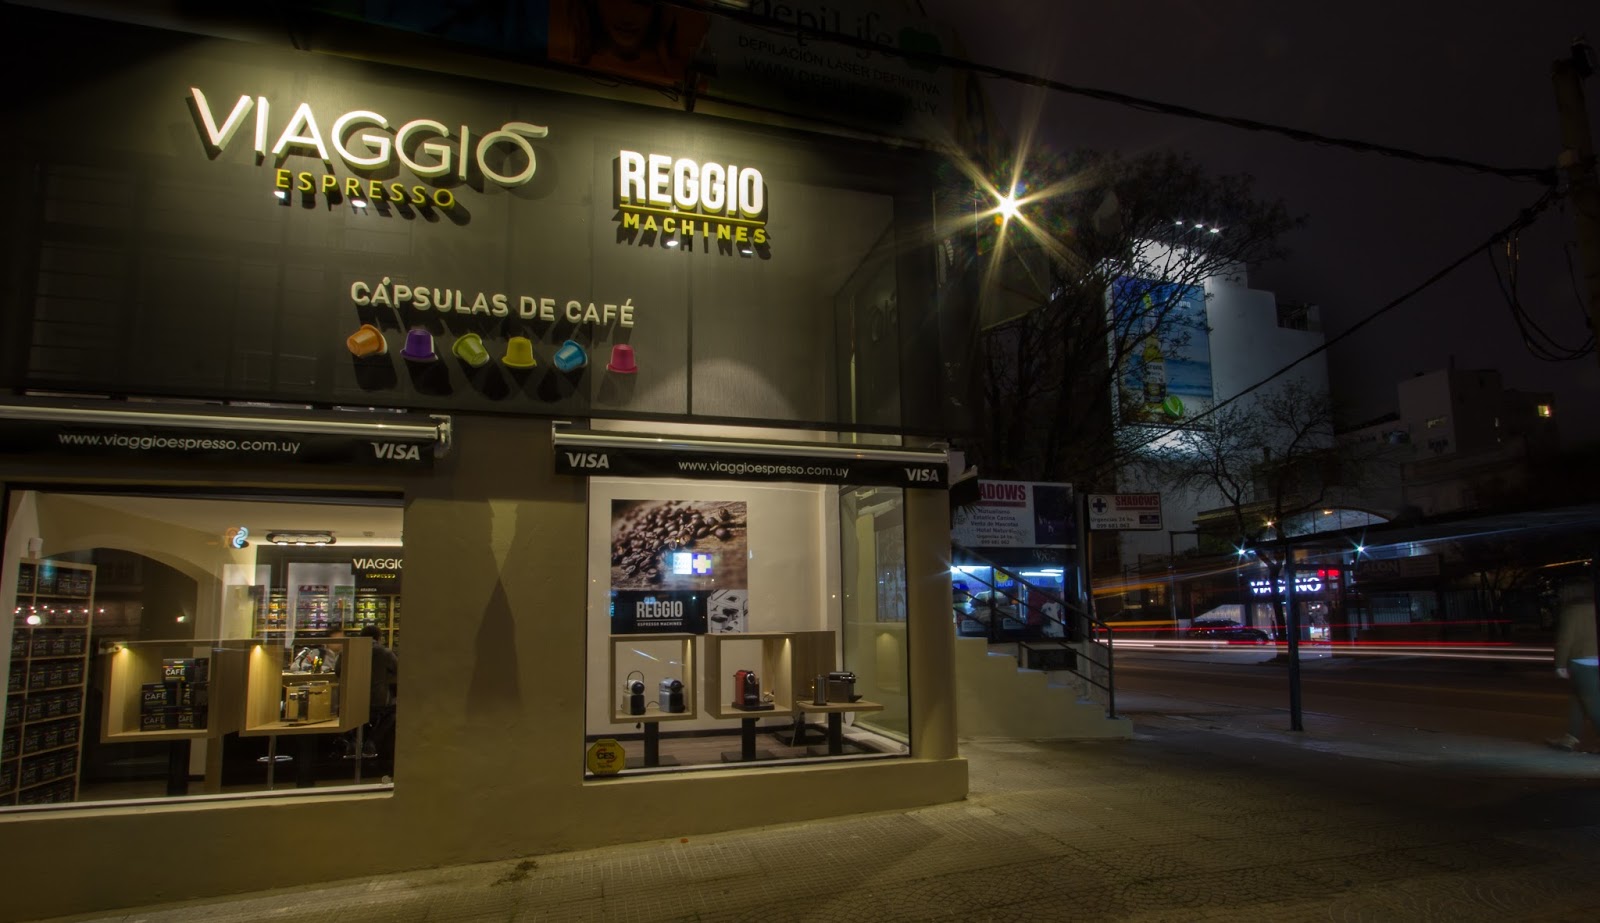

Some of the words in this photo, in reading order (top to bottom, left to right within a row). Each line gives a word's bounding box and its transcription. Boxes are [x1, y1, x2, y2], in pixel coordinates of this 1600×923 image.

[275, 169, 456, 209] ESPRESSO
[619, 149, 764, 219] REGGIO
[623, 212, 767, 244] MACHINES
[350, 276, 508, 318] CÁPSULAS
[519, 295, 556, 322] DE
[565, 298, 635, 328] CAFÉ
[58, 432, 301, 455] www.viaggioespresso.com.uy
[370, 441, 422, 462] VISA
[565, 451, 610, 470] VISA
[678, 459, 849, 479] www.viaggioespresso.com.uy
[904, 466, 940, 483] VISA
[977, 483, 1026, 501] ADOWS
[1115, 495, 1159, 506] SHADOWS
[636, 600, 683, 619] REGGIO
